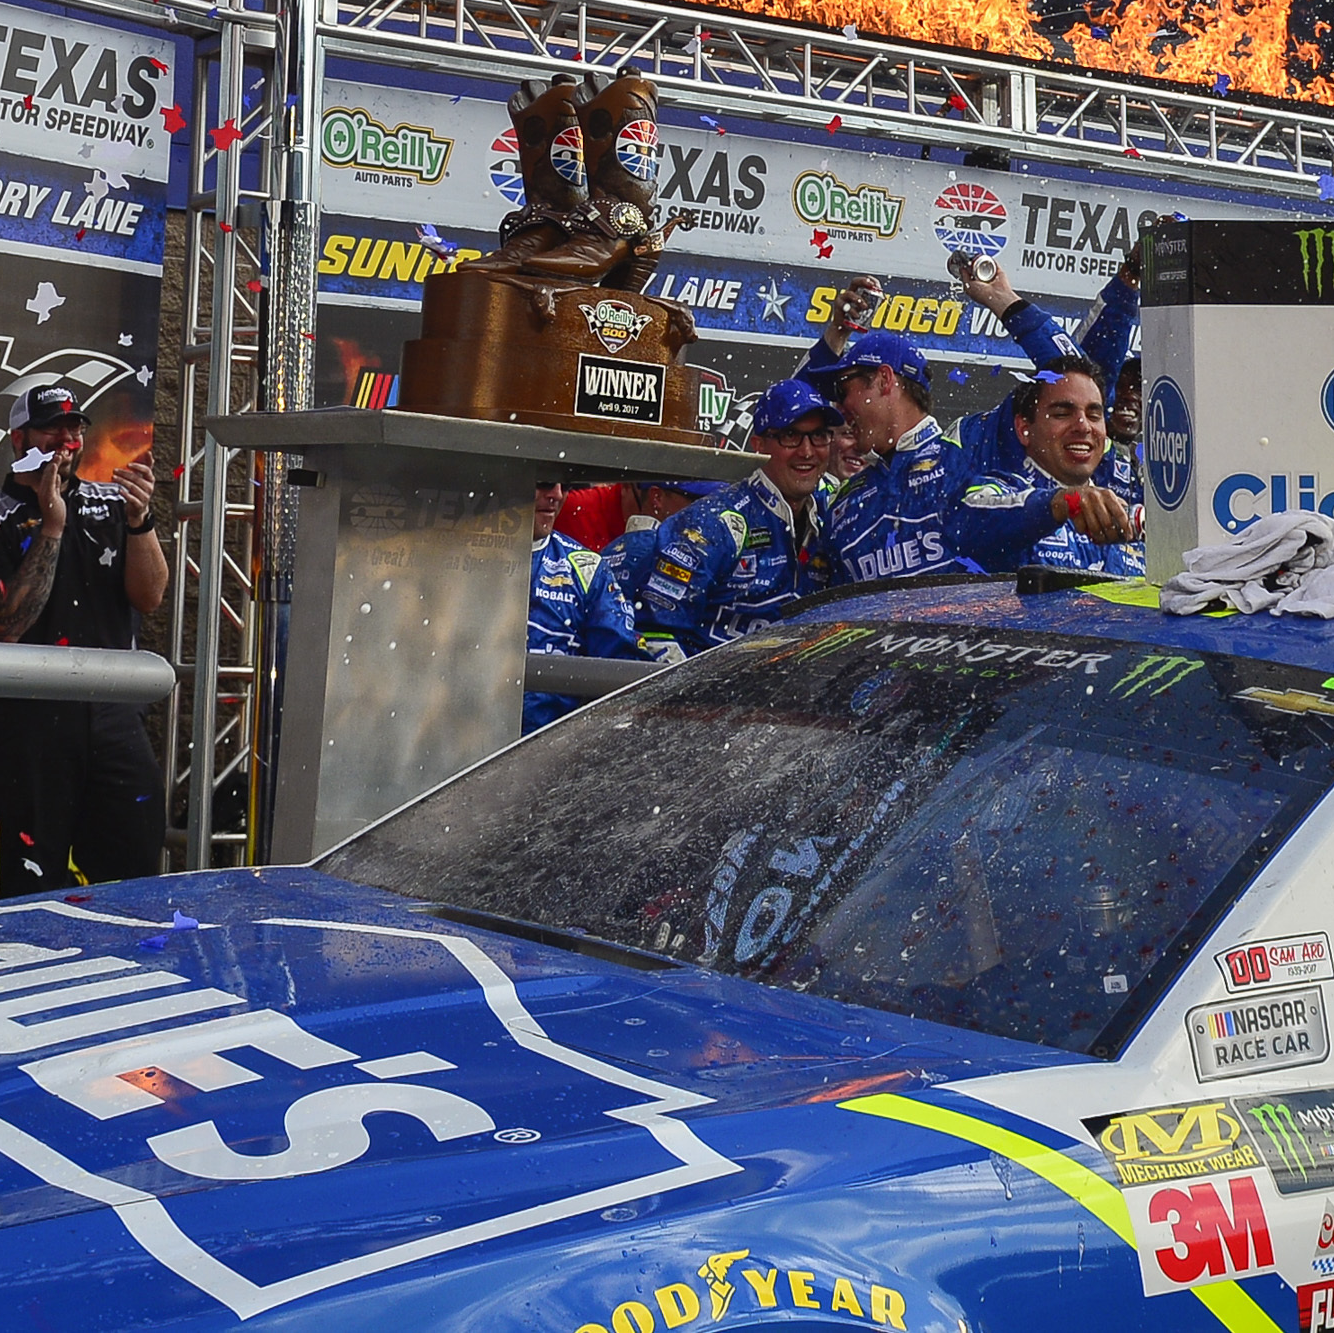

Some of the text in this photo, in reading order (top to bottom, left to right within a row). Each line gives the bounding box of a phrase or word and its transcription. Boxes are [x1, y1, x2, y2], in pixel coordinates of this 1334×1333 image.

[44, 105, 149, 150] SPEEDWAY
[322, 112, 450, 181] O'Reilly
[355, 172, 414, 189] AUTO PARTS
[654, 143, 768, 212] XAS
[51, 191, 145, 237] LANE
[796, 173, 901, 233] O'Reilly
[848, 230, 874, 243] PARTS
[1021, 250, 1124, 278] MOTOR SPEE
[653, 270, 743, 312] LANE
[597, 303, 636, 327] O'Reilly
[805, 286, 960, 336] SNOCO
[602, 328, 628, 339] 500
[584, 365, 658, 403] WINNER
[598, 401, 640, 415] April 9, 2017
[1149, 399, 1188, 493] Kroger
[909, 467, 945, 487] KOBALT
[843, 530, 945, 583] LOWE'S
[535, 586, 576, 604] KOBALT
[866, 634, 1112, 674] MONSTER
[890, 659, 1021, 680] ENERGY
[1288, 964, 1317, 976] 1939-2017
[1232, 999, 1308, 1036] NASCAR
[1215, 1032, 1310, 1066] RACE CAR
[1114, 1145, 1259, 1185] MECHANIX WEAR
[1148, 1176, 1276, 1284] 3M
[573, 1249, 908, 1333] ODYEAR
